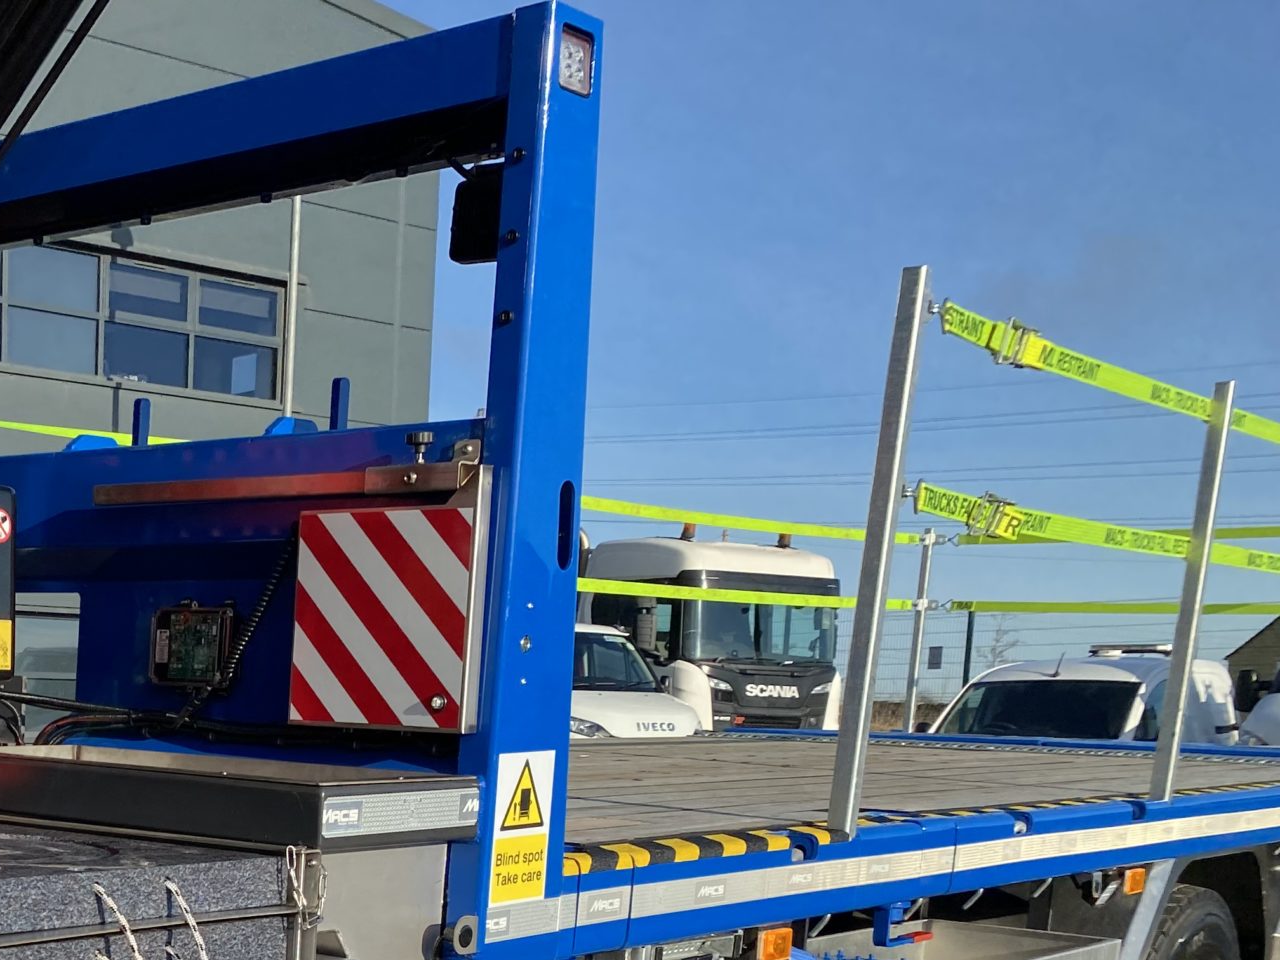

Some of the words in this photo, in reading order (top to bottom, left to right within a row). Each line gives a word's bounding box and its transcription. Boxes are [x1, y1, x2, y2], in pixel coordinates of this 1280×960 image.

[923, 486, 960, 515] TRUCKS
[745, 683, 799, 699] SCANIA
[636, 722, 676, 732] IVECO
[496, 851, 520, 867] Blind
[523, 848, 544, 869] spot
[495, 871, 519, 887] Take
[521, 869, 542, 885] care
[697, 884, 725, 898] MACS
[589, 897, 621, 913] MACS
